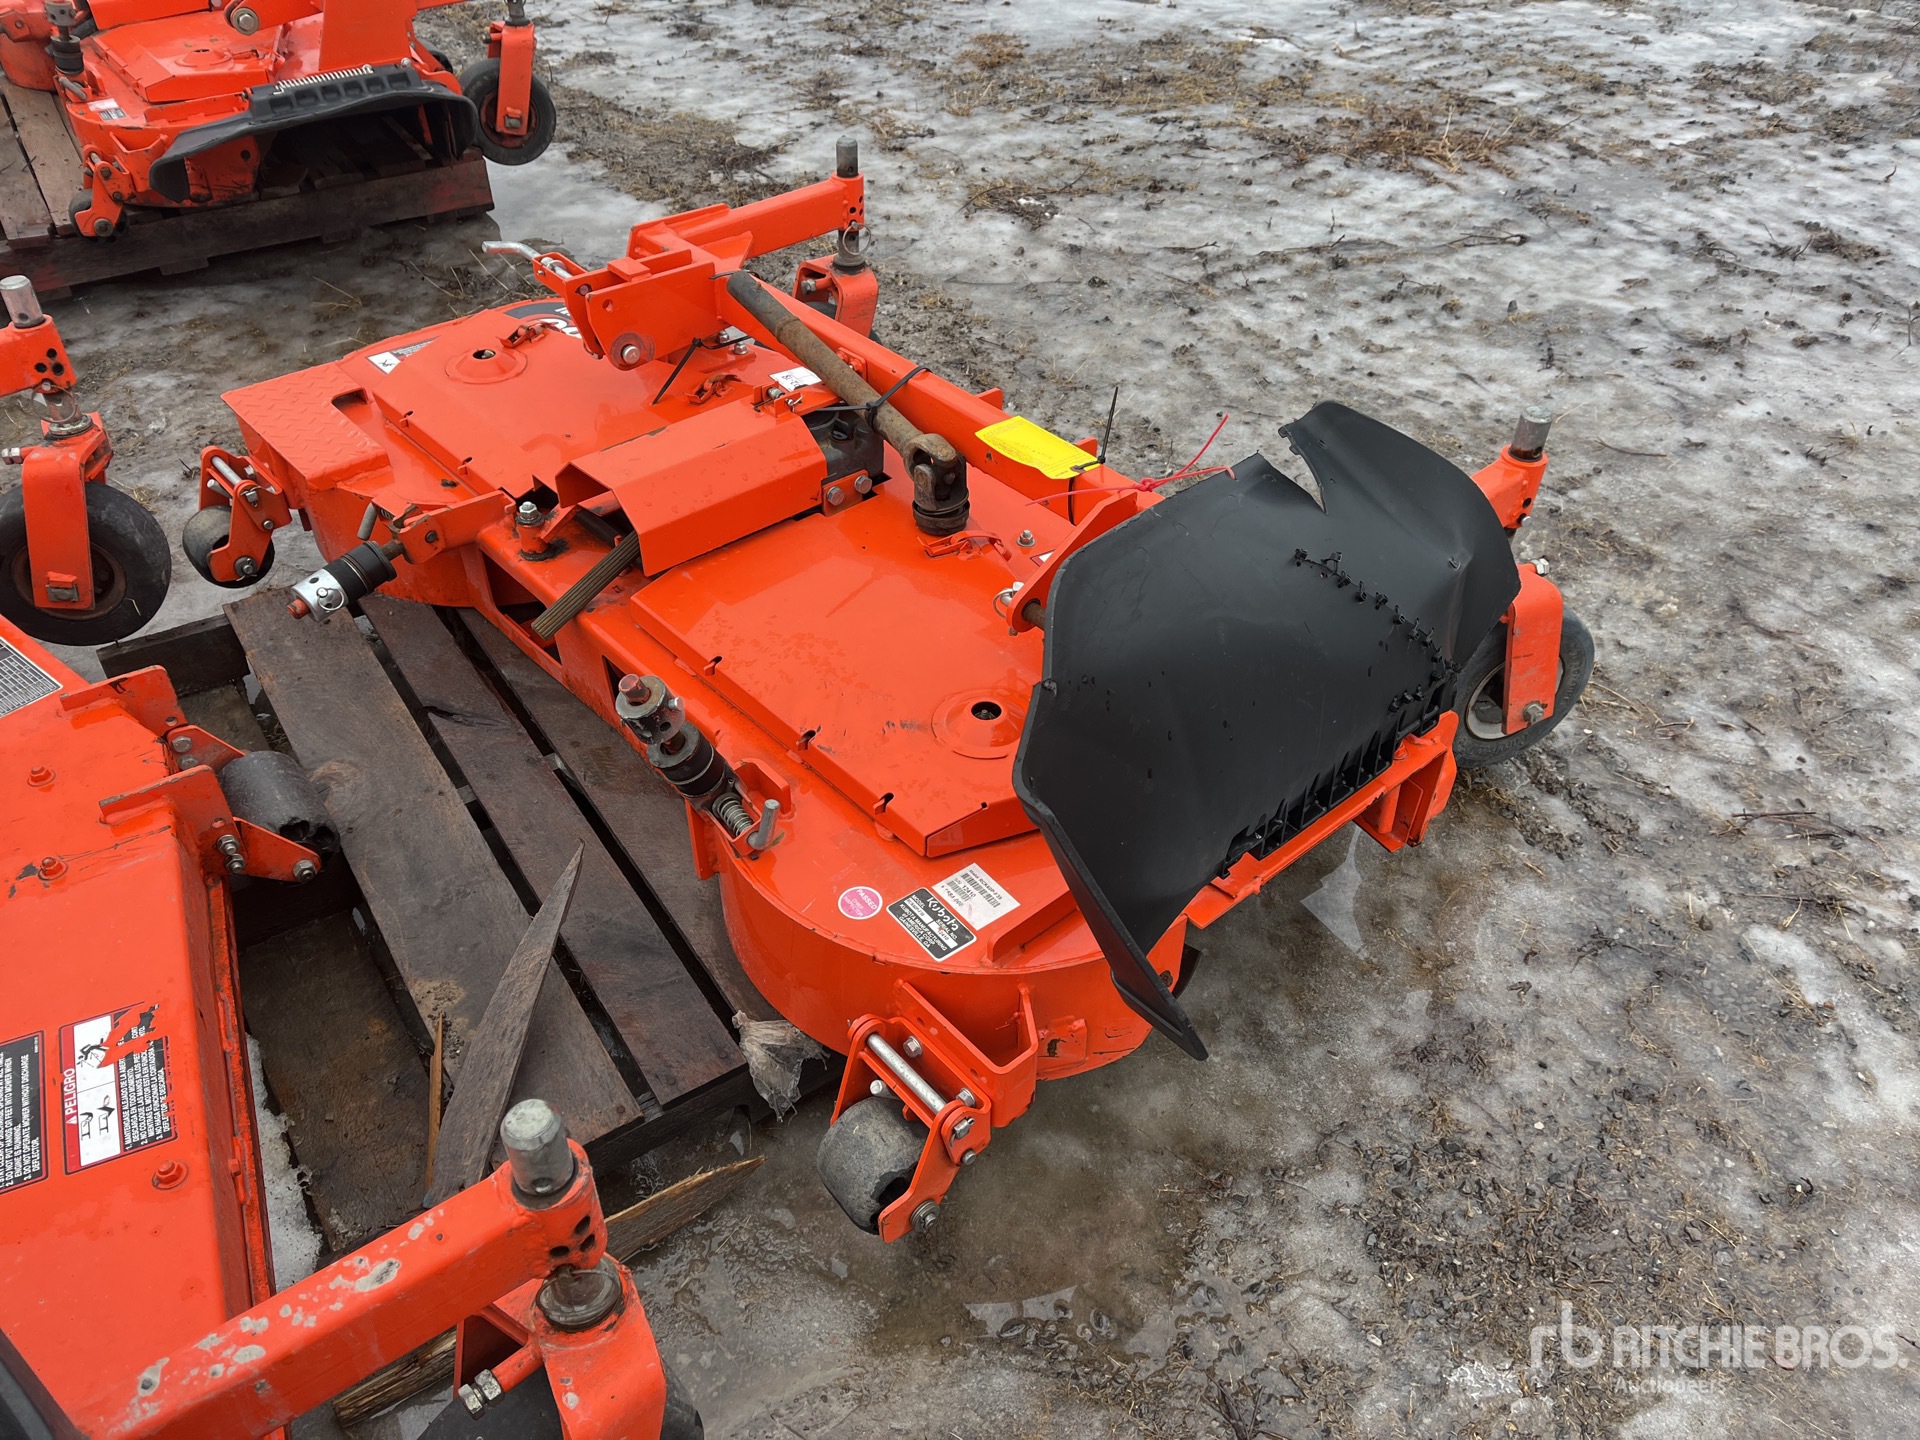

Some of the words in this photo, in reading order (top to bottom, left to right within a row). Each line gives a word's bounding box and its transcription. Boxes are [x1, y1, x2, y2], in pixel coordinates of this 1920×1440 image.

[854, 888, 878, 910] PASSED
[910, 894, 926, 908] MODEL
[926, 896, 960, 931] Kubota
[898, 903, 916, 919] KUBOTA
[913, 918, 947, 950] MANUFACTURING
[905, 916, 924, 934] AMERICA
[4, 1056, 12, 1073] WHEN
[141, 1065, 148, 1074] EN
[147, 1046, 156, 1077] CORTADORA
[4, 1072, 12, 1093] MOWER
[119, 1072, 126, 1080] LA
[121, 1079, 126, 1087] DE
[127, 1066, 135, 1092] MOMENTO.
[150, 1075, 157, 1083] LA
[157, 1067, 166, 1095] DESCARGA.
[21, 1082, 29, 1107] WITHOUT
[63, 1066, 76, 1115] PELIGRO
[135, 1078, 143, 1096] MANOS
[151, 1082, 159, 1111] FUNCIONAR
[130, 1105, 136, 1114] EN
[145, 1103, 151, 1111] EL
[5, 1118, 12, 1128] OR
[137, 1105, 145, 1131] COLOQUE
[146, 1110, 154, 1137] MIENTRAS
[130, 1113, 139, 1142] DESCARGA
[140, 1130, 146, 1139] NO
[155, 1125, 161, 1134] NO
[22, 1126, 30, 1153] OPERATE
[22, 1151, 30, 1165] NOT
[31, 1136, 39, 1172] DEFLECTOR.
[5, 1170, 13, 1181] DO
[23, 1164, 30, 1175] DO
